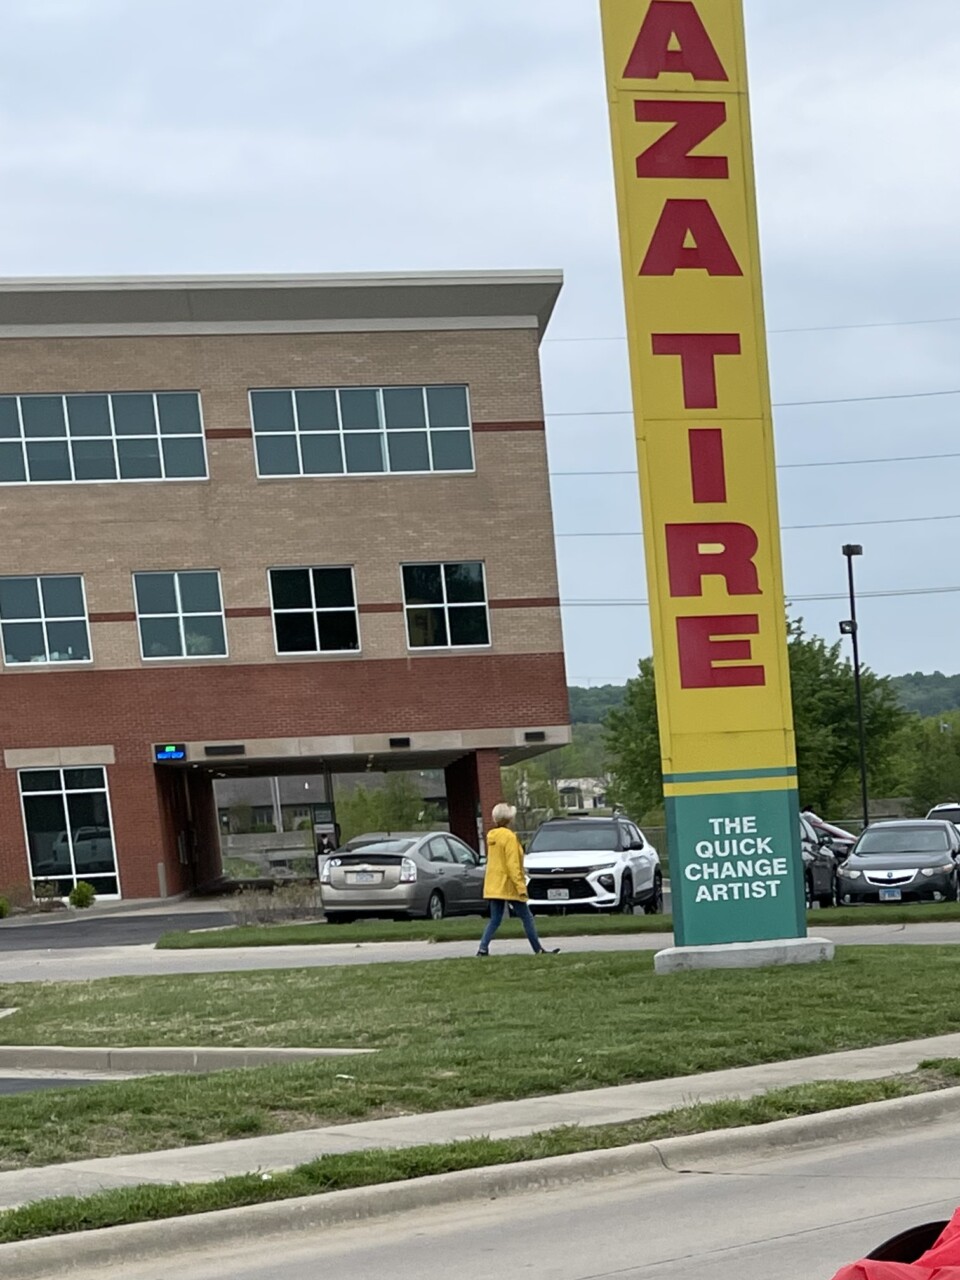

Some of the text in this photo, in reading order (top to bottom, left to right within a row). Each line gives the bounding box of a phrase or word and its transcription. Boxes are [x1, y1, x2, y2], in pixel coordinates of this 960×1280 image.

[651, 333, 765, 688] TIRE
[708, 816, 757, 835] THE
[695, 837, 773, 859] QUICK
[684, 858, 788, 881] CHANGE
[695, 880, 781, 902] ARTIST
